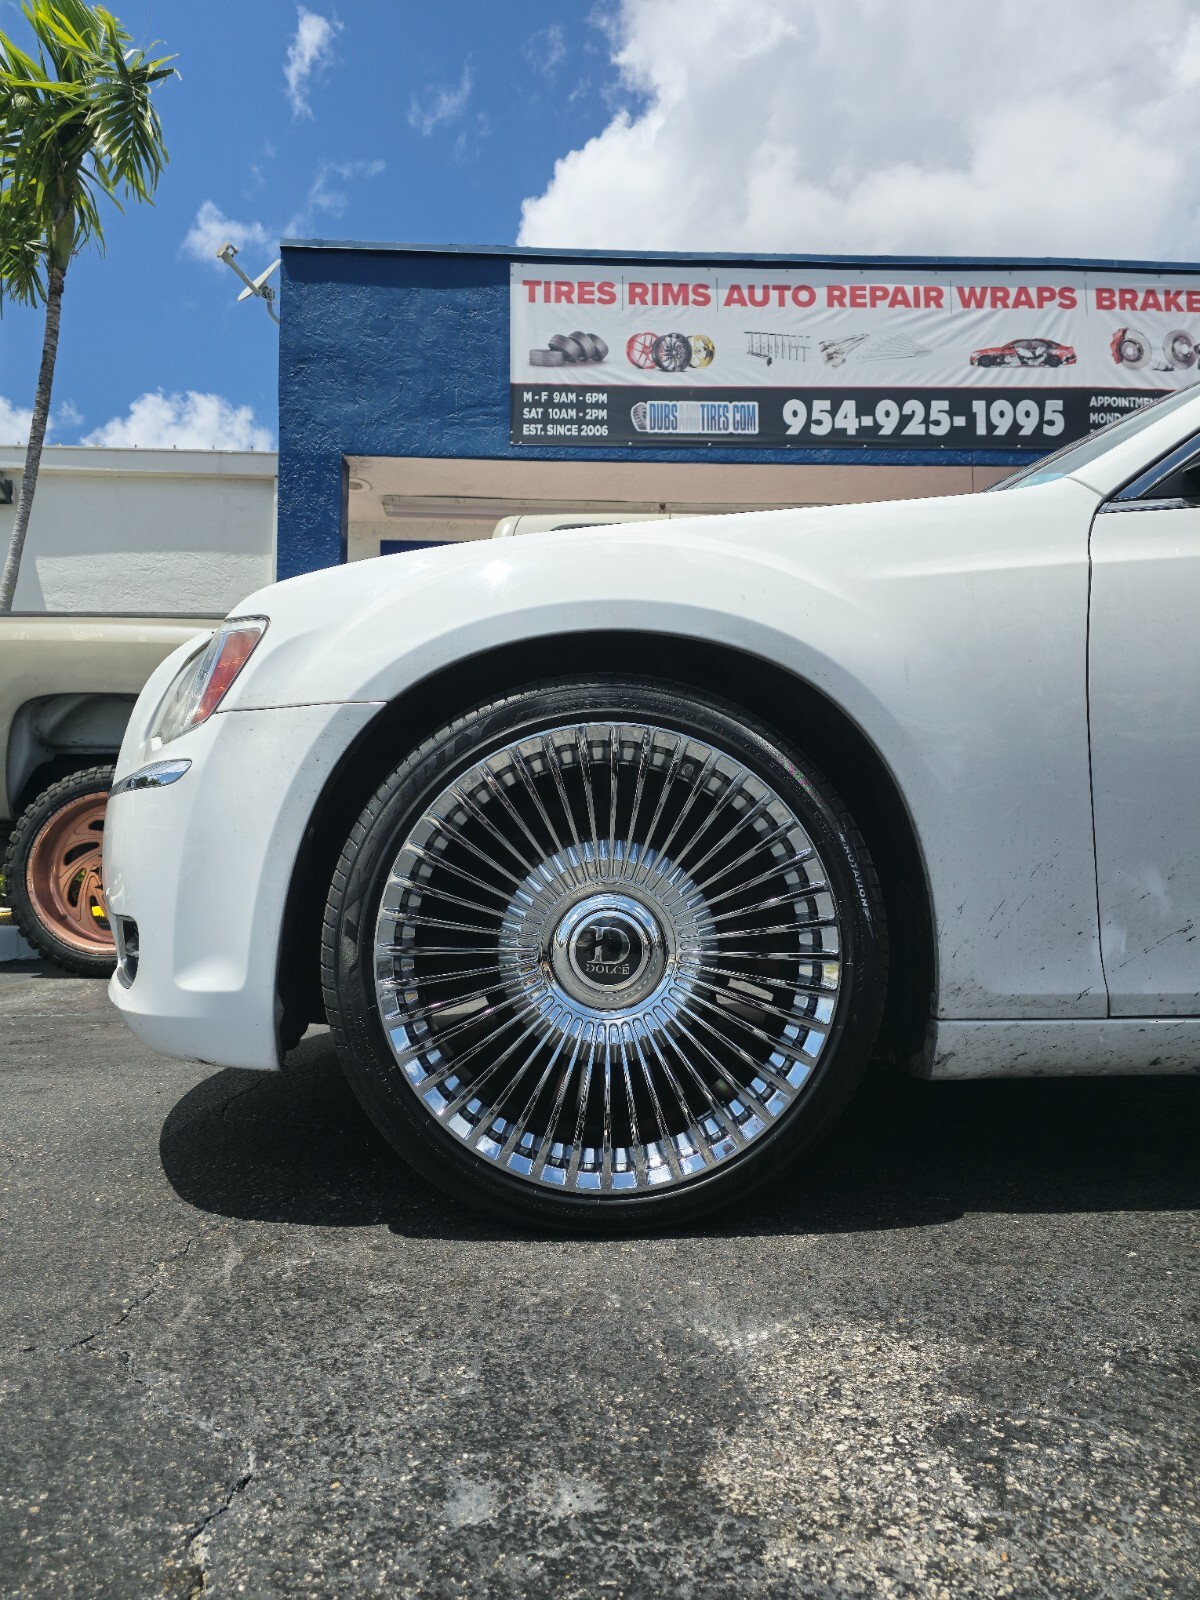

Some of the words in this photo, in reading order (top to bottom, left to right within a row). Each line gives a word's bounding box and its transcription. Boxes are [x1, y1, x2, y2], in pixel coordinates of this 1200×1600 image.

[522, 280, 617, 305] TIRES
[628, 282, 711, 307] RIMS
[724, 284, 817, 308] AUTO
[826, 285, 944, 309] REPAIR
[957, 286, 1077, 309] WRAPS
[1095, 288, 1200, 313] BRAKE
[523, 391, 532, 402] M
[541, 392, 548, 402] F
[553, 392, 577, 403] 9AM
[585, 393, 608, 404] 6PM
[523, 408, 543, 419] SAT
[548, 408, 577, 420] 10AM
[585, 409, 608, 420] 2PM
[782, 398, 1065, 436] 954-925-1995
[522, 424, 545, 435] EST.
[547, 424, 579, 435] SINCE
[580, 425, 609, 436] 2006
